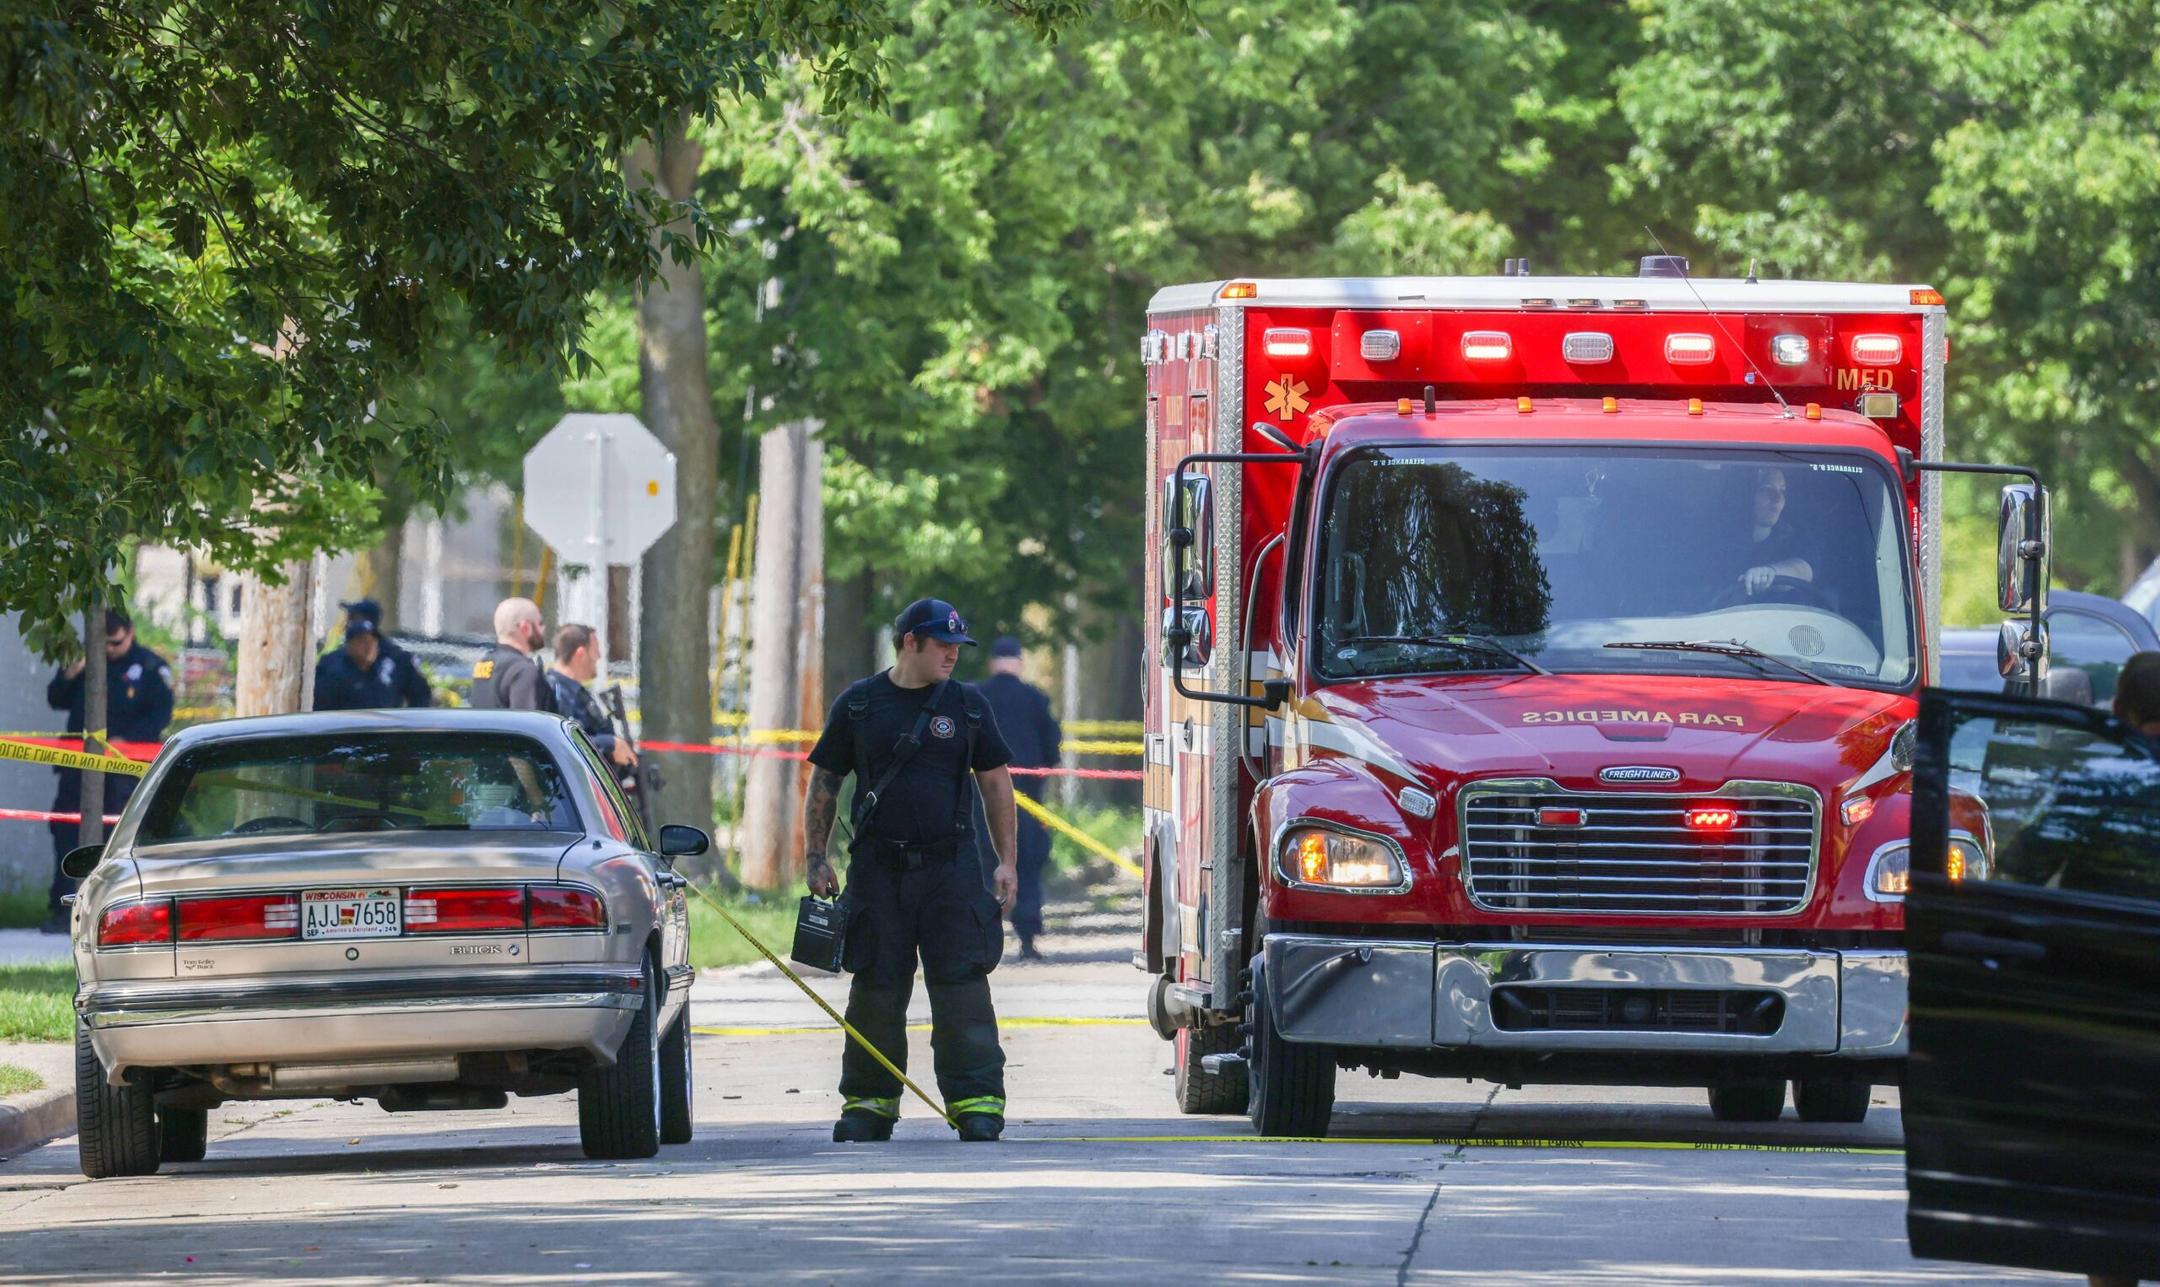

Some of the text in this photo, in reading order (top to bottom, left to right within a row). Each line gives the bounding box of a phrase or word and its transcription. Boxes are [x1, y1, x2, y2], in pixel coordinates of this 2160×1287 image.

[1837, 368, 1894, 391] MED
[1607, 769, 1673, 781] FREIGHTLINER
[305, 891, 357, 901] WISCONSIN
[306, 929, 320, 937] SEP
[450, 945, 502, 955] BUICK
